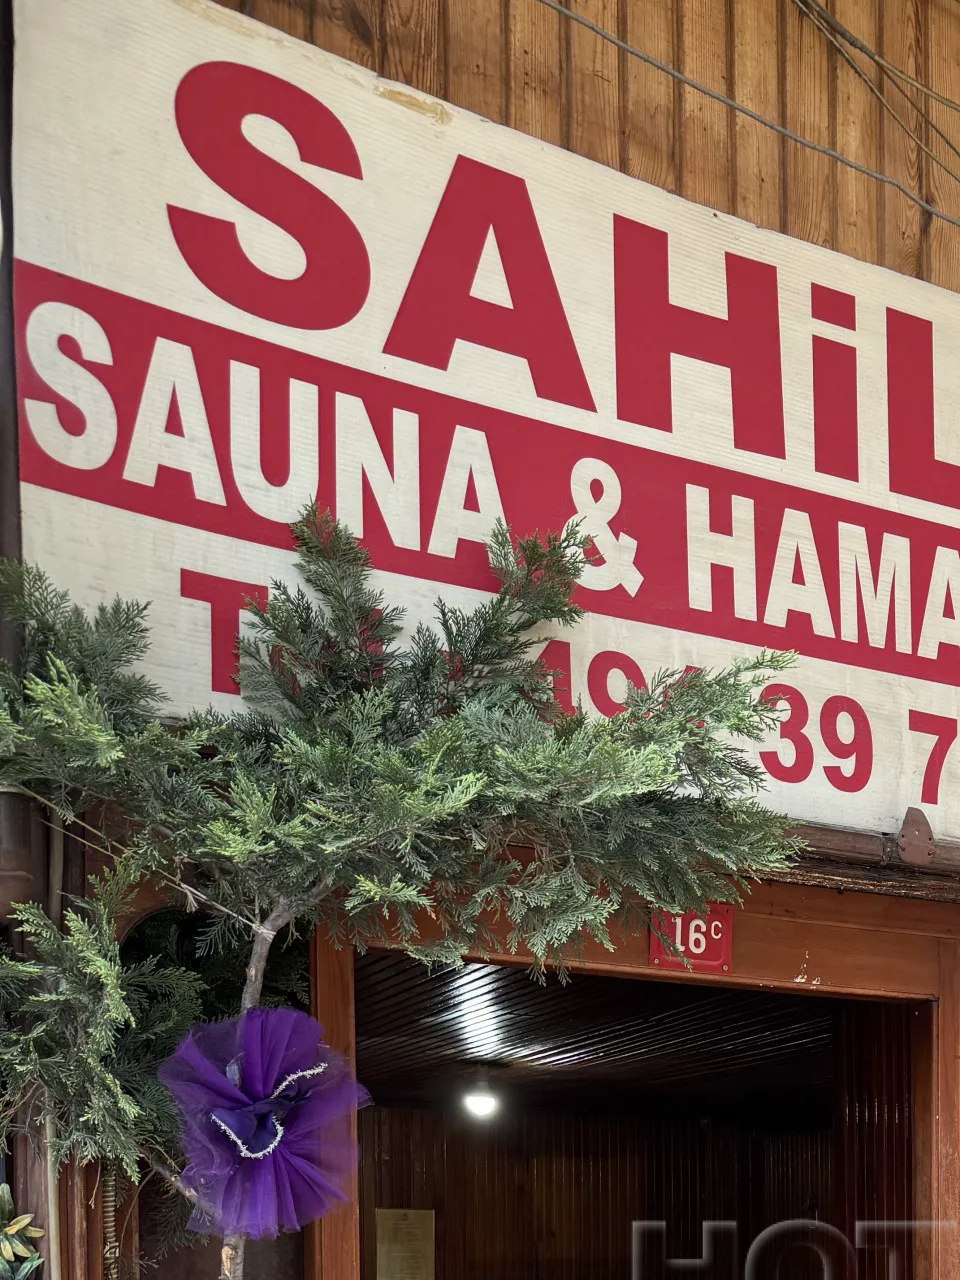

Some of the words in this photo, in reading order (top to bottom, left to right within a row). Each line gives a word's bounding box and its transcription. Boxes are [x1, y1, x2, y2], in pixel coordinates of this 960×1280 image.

[23, 300, 512, 559] SAUNA
[562, 456, 644, 597] &
[759, 683, 873, 791] 39
